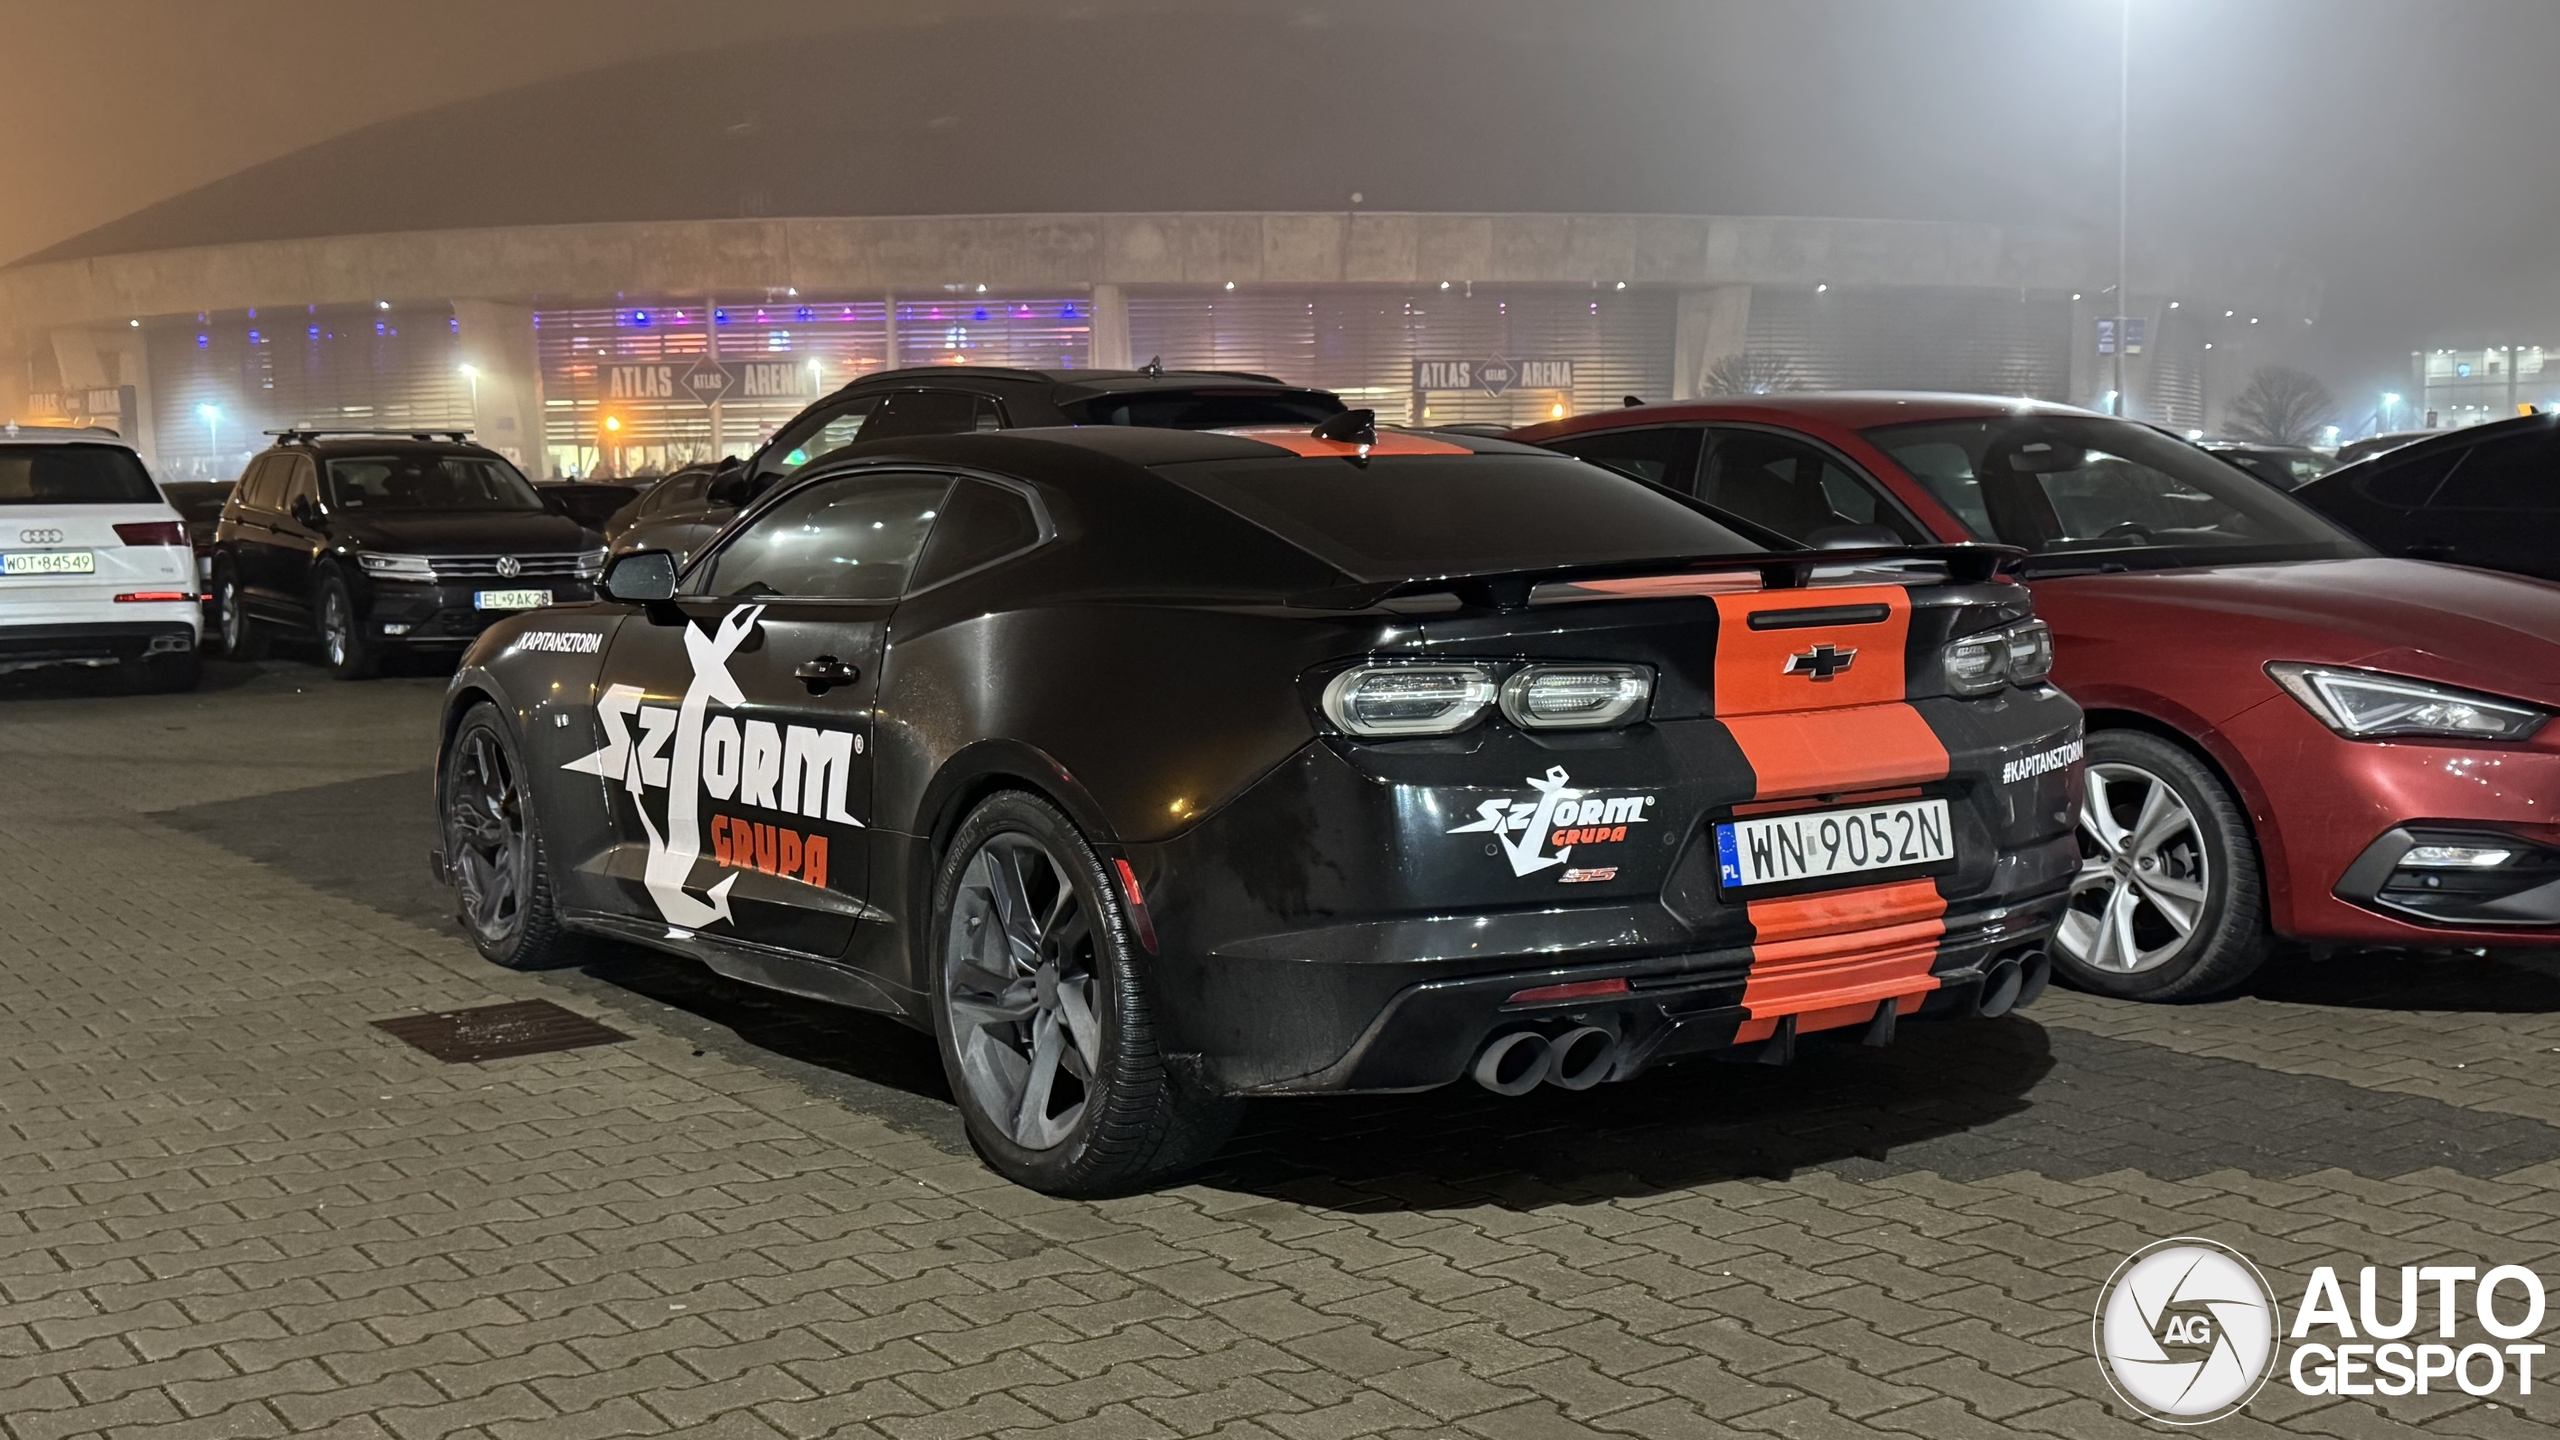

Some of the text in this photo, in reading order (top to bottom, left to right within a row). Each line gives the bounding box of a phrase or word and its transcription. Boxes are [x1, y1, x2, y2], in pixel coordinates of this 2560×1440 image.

[610, 363, 809, 397] ATLAS ATLAS ARENA
[1420, 362, 1470, 388] ATLAS
[1521, 362, 1572, 387] ARENA
[518, 631, 603, 654] KAPITANSZTORM
[2002, 738, 2084, 785] #KAPITANSZTORM
[1551, 825, 1628, 847] GRUPA
[1747, 805, 1945, 880] WN 9052N
[710, 814, 829, 889] GRUPA
[1722, 864, 1739, 880] PL
